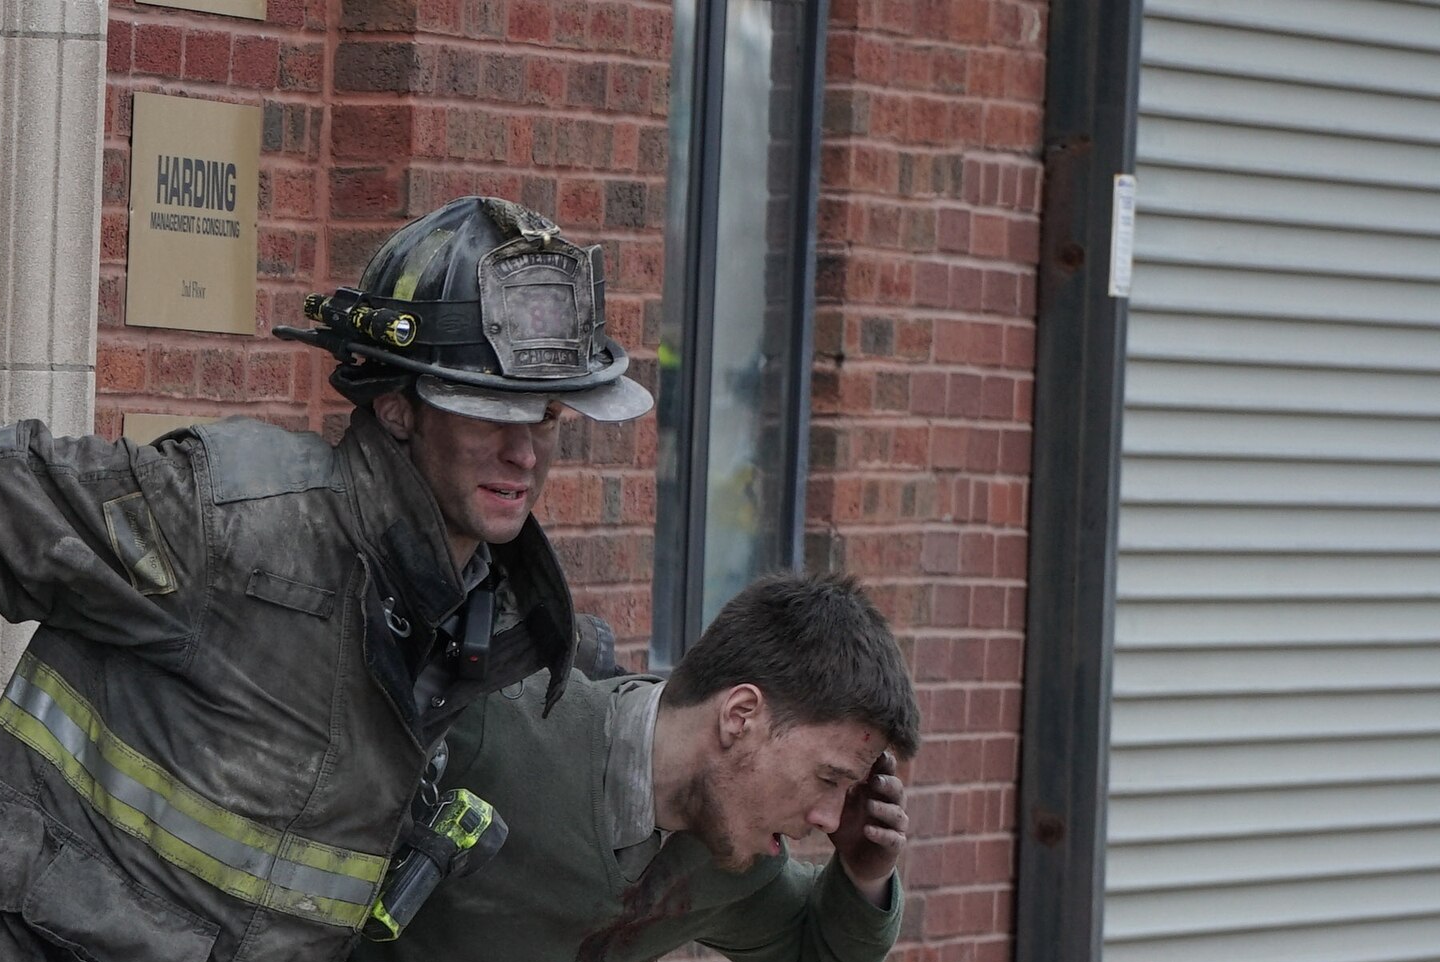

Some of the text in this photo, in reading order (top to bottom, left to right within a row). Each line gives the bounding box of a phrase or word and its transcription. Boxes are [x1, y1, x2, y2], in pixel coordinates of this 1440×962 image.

[157, 155, 236, 212] HARDING
[151, 212, 240, 238] MANAGEMENT & CONSULTING
